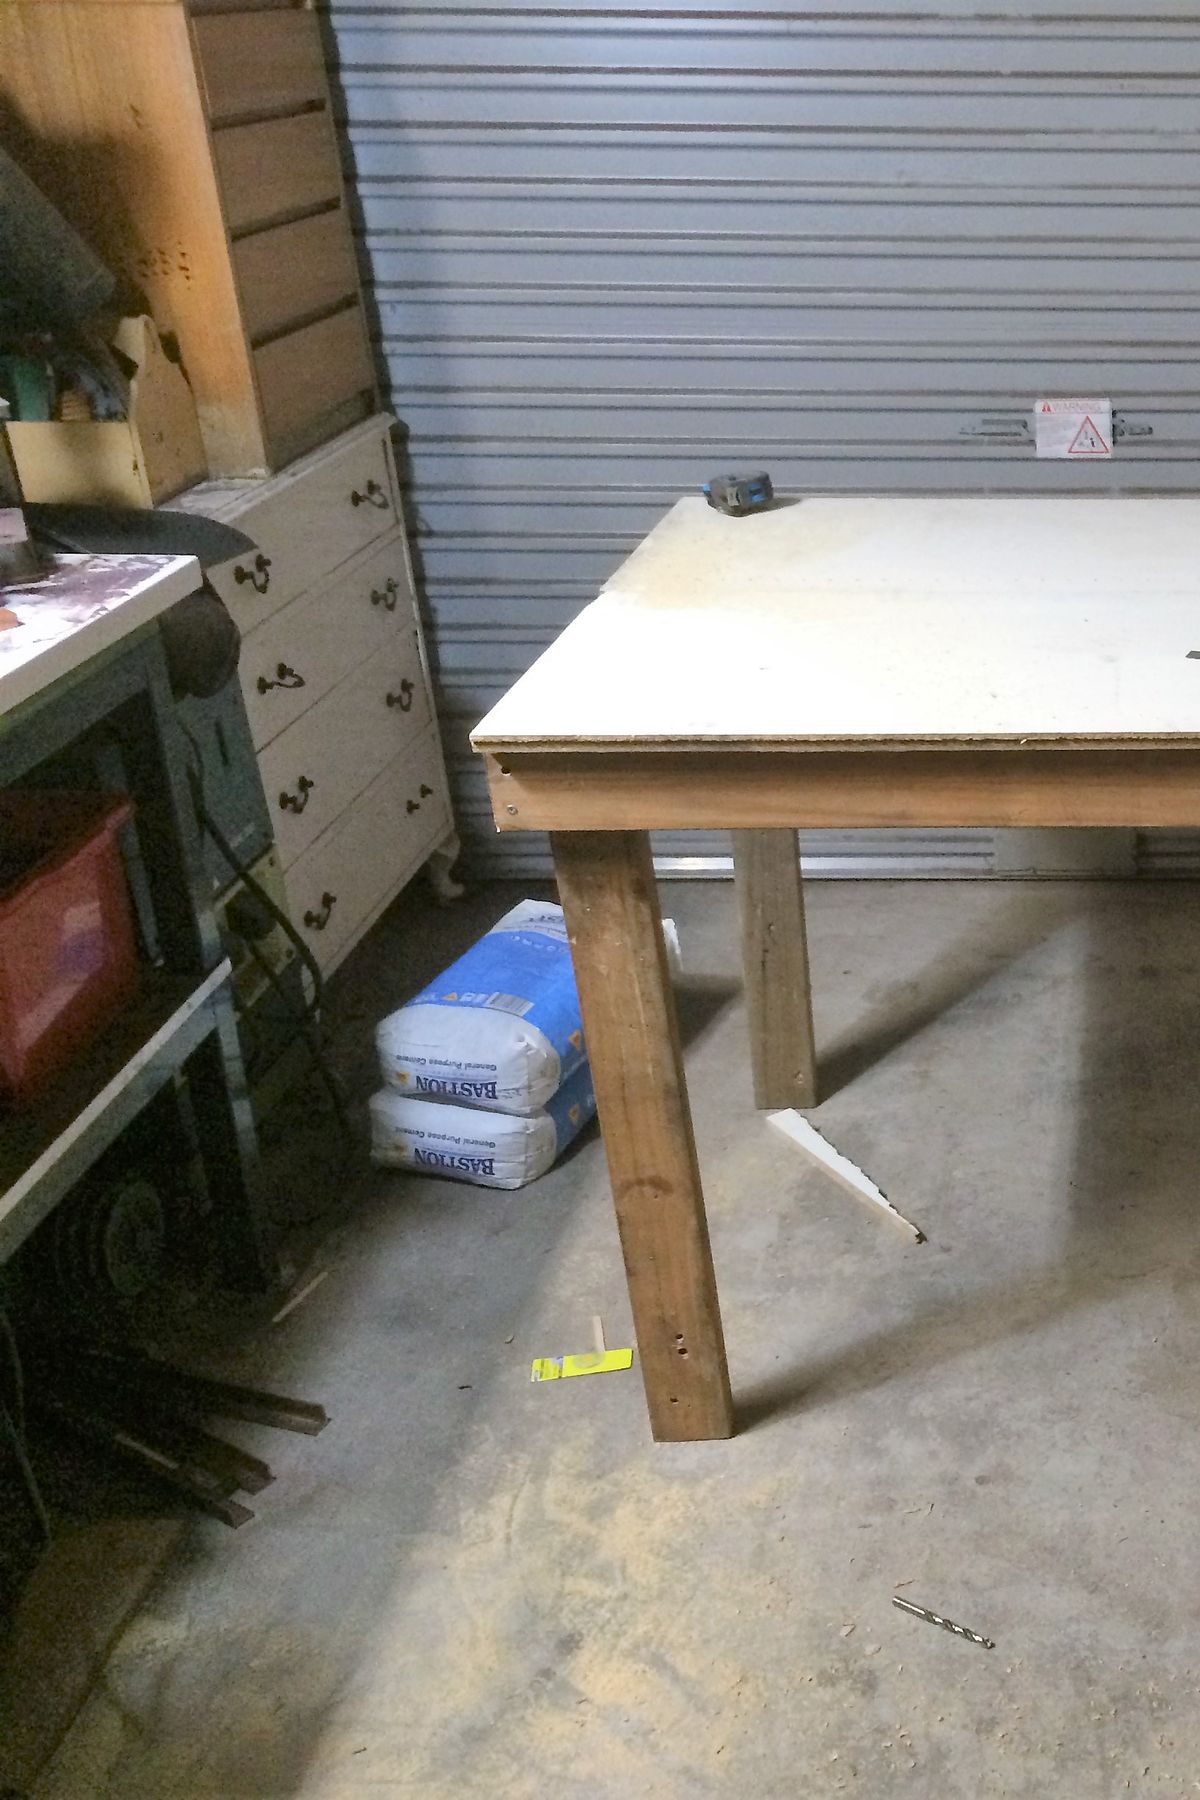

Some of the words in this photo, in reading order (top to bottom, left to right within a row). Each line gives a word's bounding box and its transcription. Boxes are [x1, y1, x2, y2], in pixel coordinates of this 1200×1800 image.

[1053, 402, 1102, 412] WARNING
[429, 1058, 462, 1070] Purpose
[464, 1061, 498, 1072] General
[415, 1075, 498, 1100] BASTION
[427, 1132, 461, 1145] Purpose
[462, 1137, 497, 1149] General
[414, 1147, 496, 1176] BASTION
